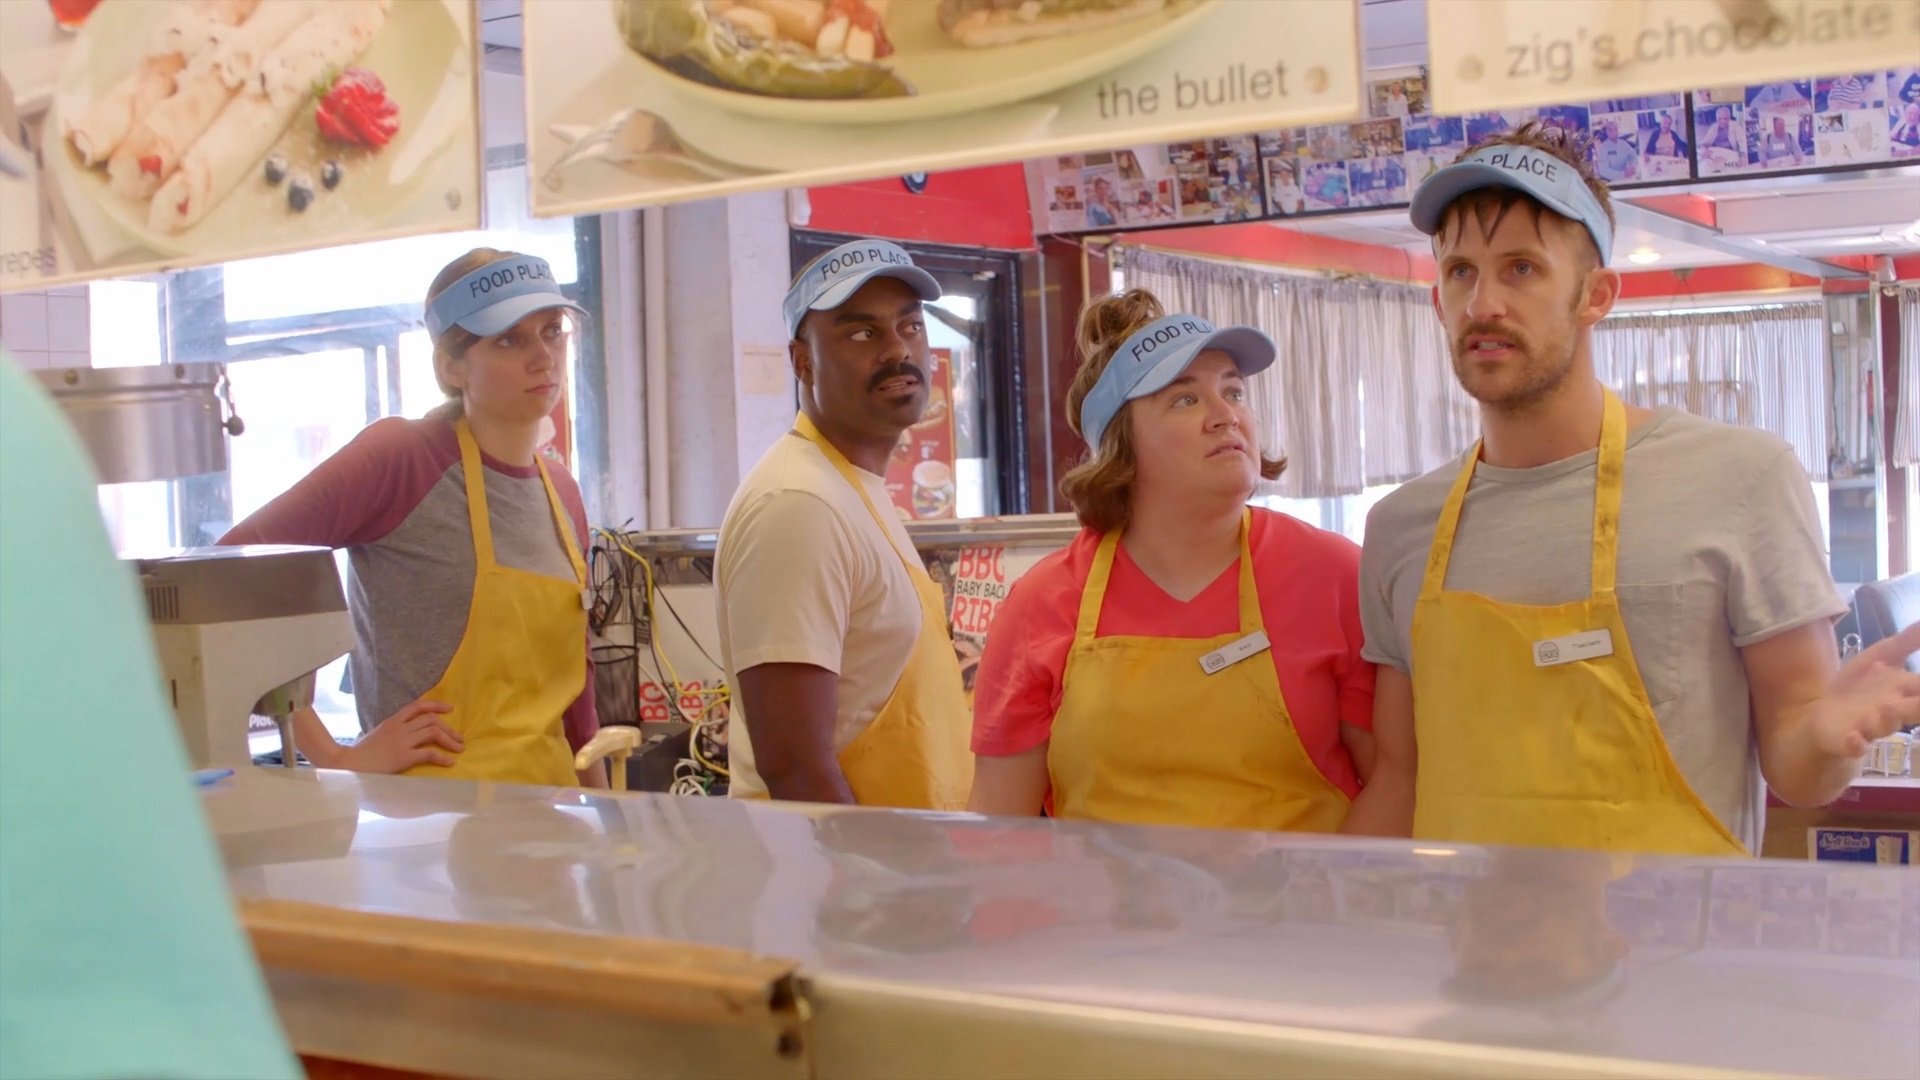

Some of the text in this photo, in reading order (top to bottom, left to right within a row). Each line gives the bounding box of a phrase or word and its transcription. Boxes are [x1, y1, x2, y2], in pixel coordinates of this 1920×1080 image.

[1504, 26, 1618, 85] zig's
[1634, 0, 1893, 63] chocolate
[1096, 60, 1288, 118] the bullet
[1491, 153, 1557, 182] PLACE
[821, 250, 864, 280] FOOD
[469, 269, 514, 298] FOOD
[1132, 325, 1181, 362] FOOD
[956, 580, 1005, 600] BABY BAC
[953, 595, 998, 633] RIB
